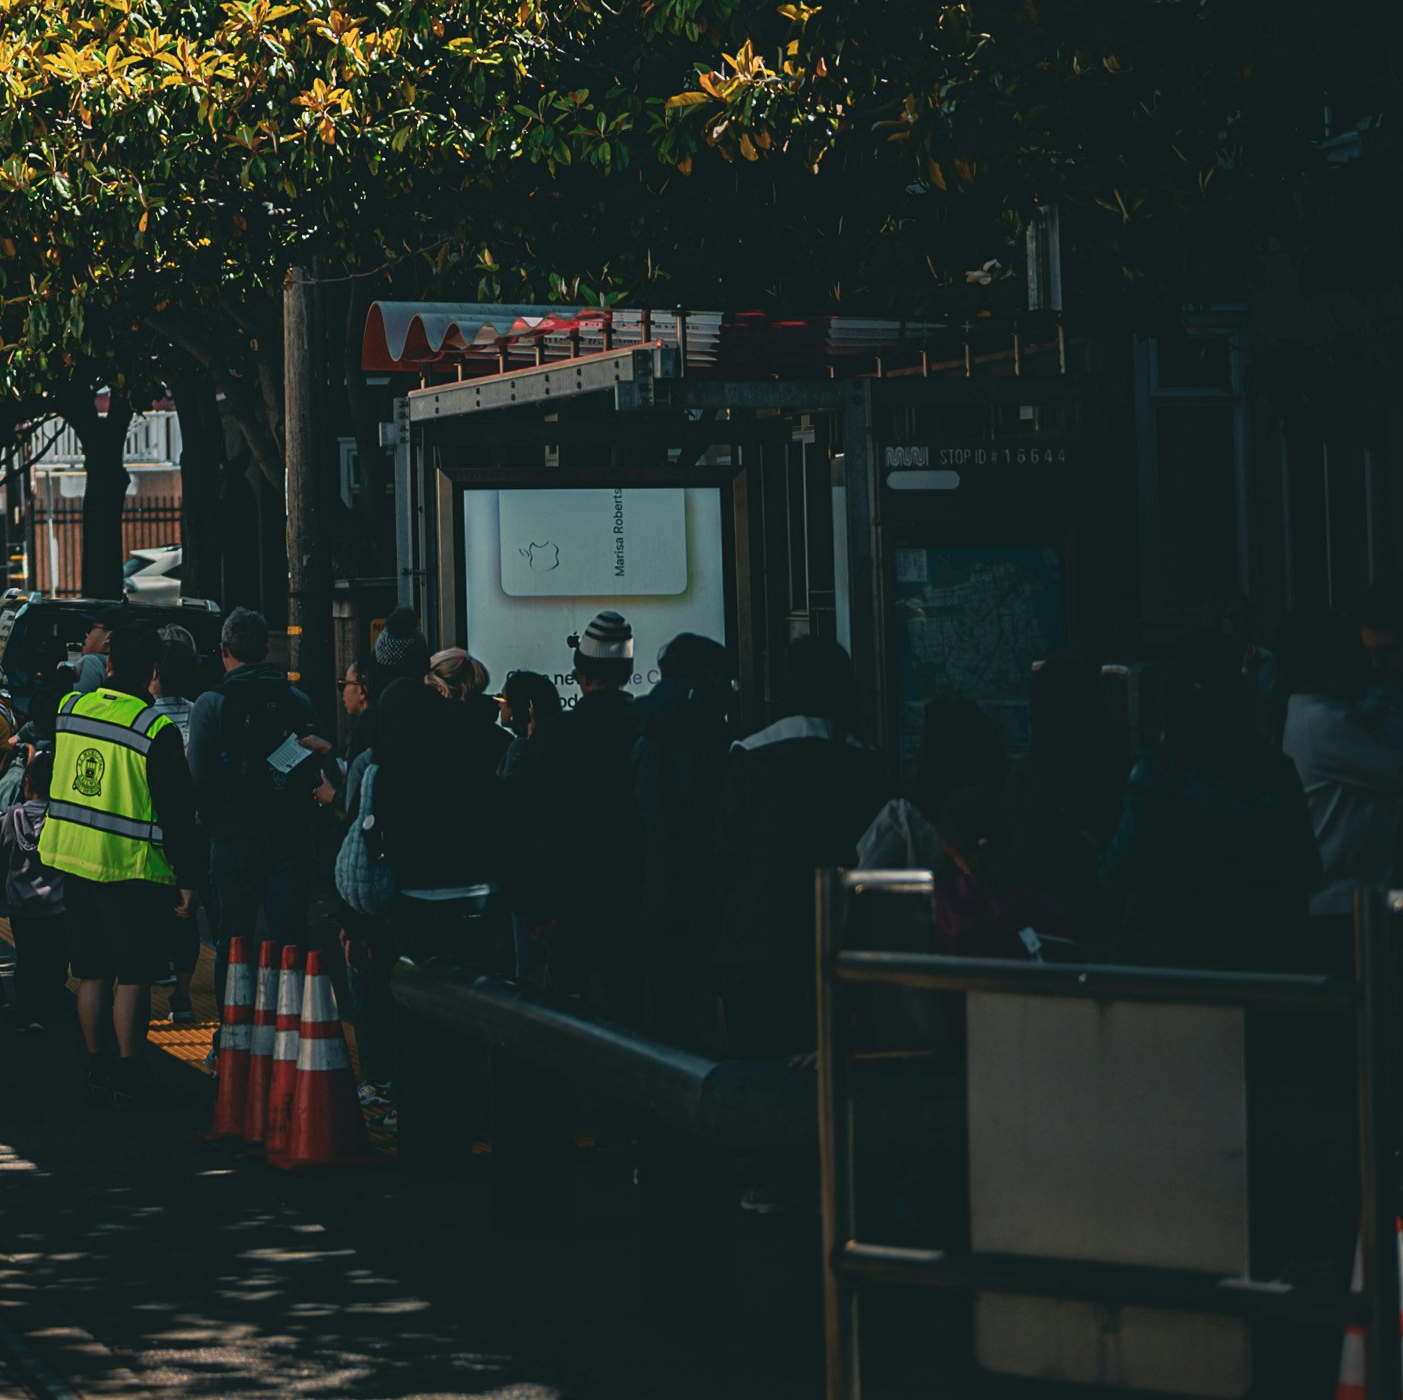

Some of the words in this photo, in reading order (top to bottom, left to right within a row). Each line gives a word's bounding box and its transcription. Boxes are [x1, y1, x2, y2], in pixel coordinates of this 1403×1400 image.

[940, 449, 971, 465] STOP
[975, 449, 987, 465] ID
[613, 488, 624, 534] Roberts
[614, 537, 625, 577] Marisa
